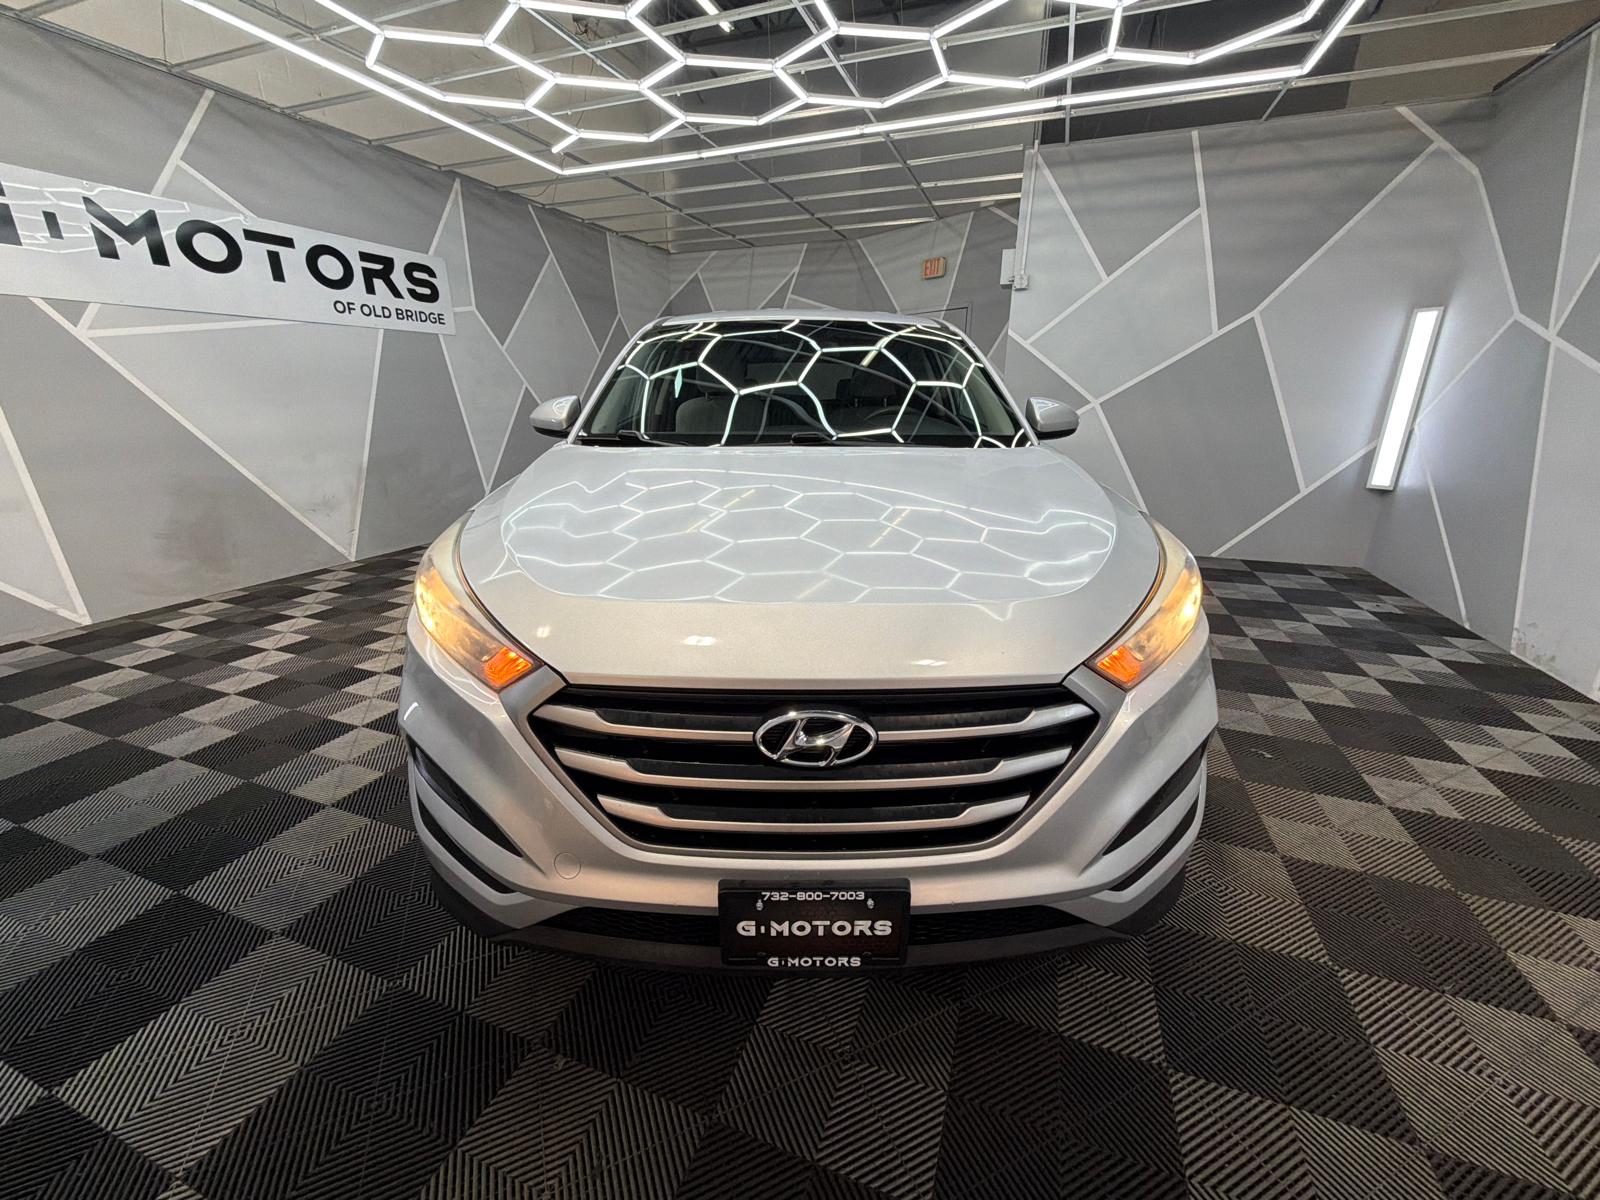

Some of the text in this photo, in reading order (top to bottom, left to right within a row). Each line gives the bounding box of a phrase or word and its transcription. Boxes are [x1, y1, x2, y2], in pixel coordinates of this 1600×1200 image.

[924, 258, 941, 277] EXIT
[333, 300, 446, 325] OF OLD BRIDGE
[761, 891, 865, 901] 732-800-7003
